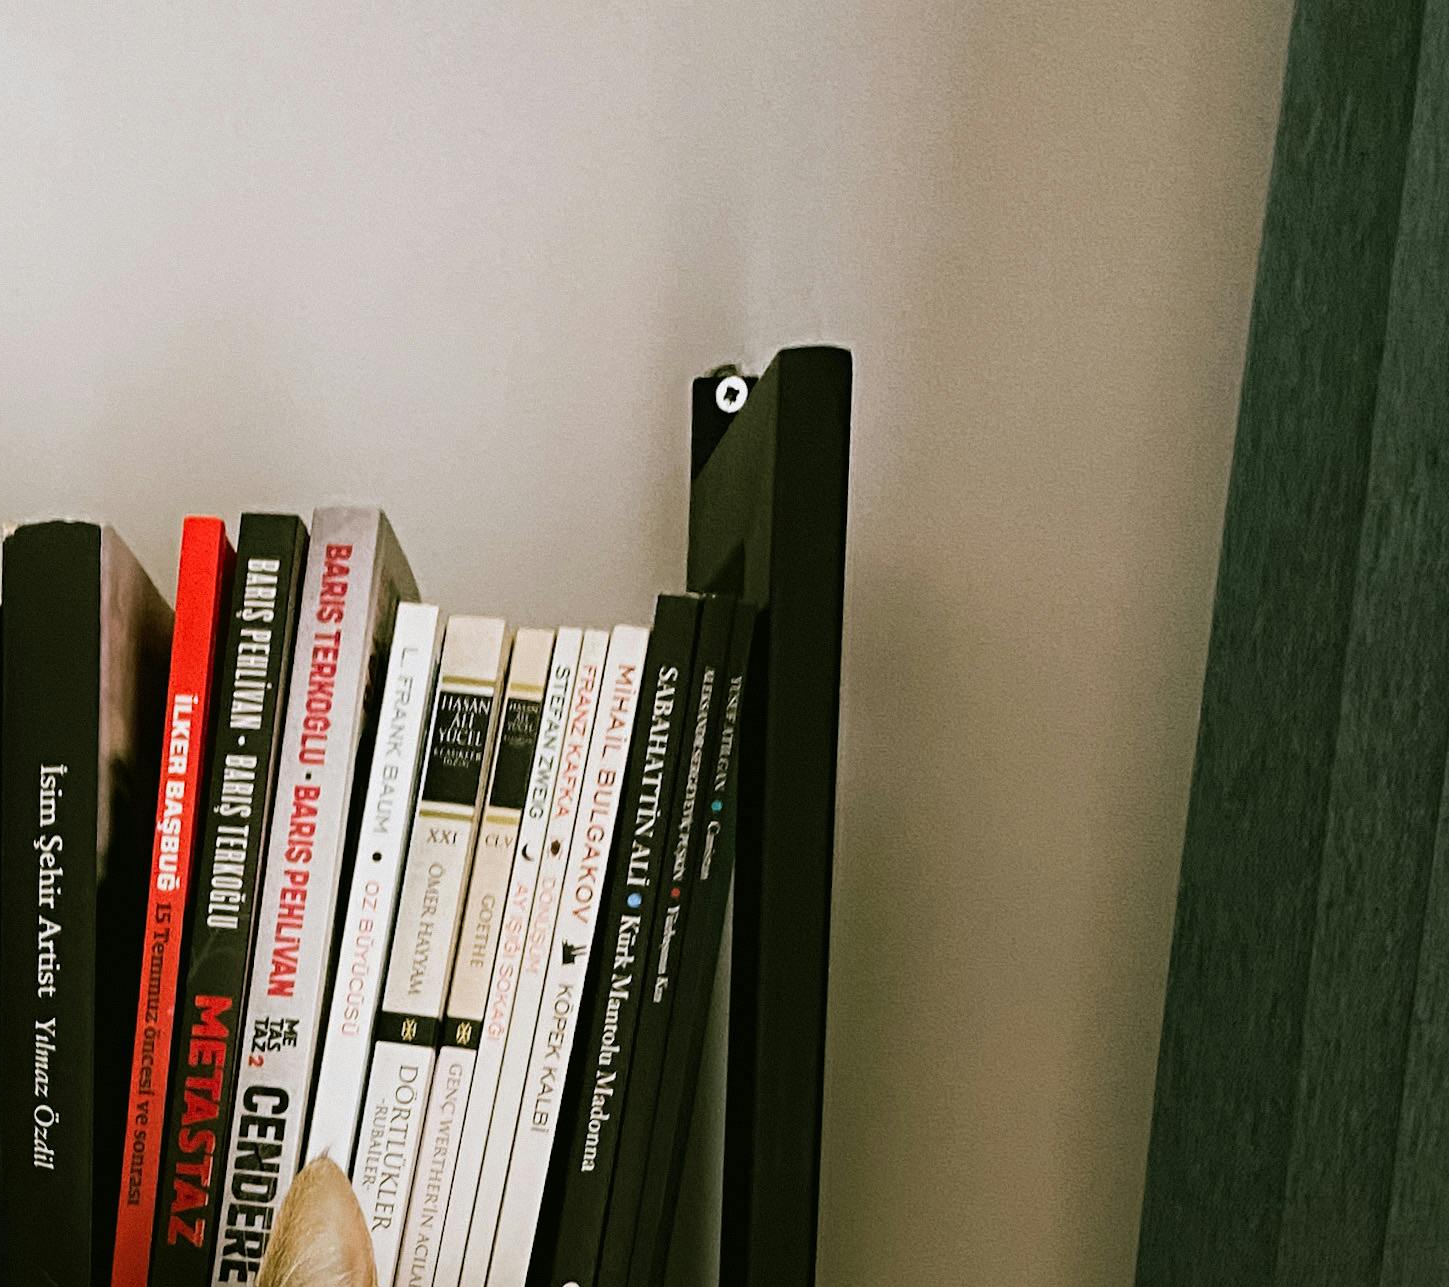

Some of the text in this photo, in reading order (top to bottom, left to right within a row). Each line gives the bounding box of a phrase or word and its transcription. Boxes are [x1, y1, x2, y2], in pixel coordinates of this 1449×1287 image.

[33, 765, 68, 1169] İsim Şehir Artist Yılmaz Özdil
[167, 995, 232, 1248] METASTAZ
[372, 1065, 418, 1232] DÖRTLÜKLER
